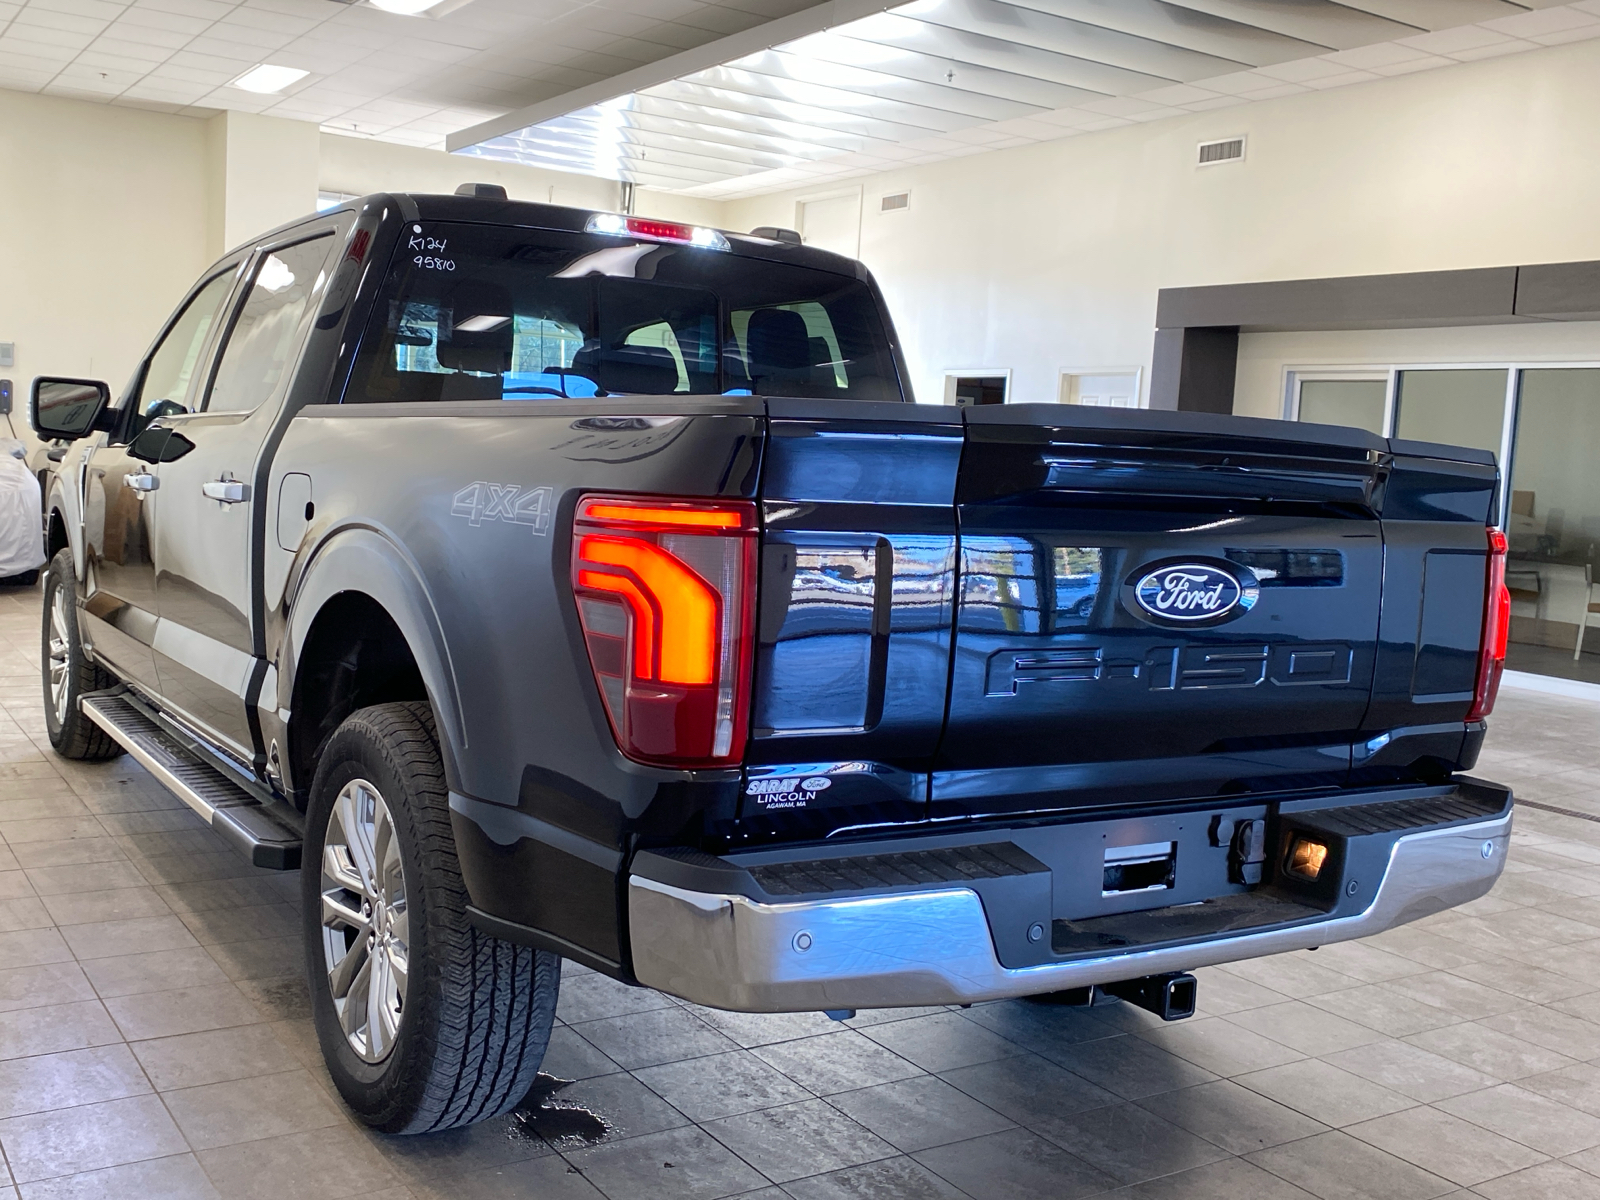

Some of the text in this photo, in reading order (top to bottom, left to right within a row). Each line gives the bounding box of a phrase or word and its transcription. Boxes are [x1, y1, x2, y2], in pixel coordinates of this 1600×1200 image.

[408, 235, 447, 252] K124
[413, 255, 456, 271] 95810
[1155, 572, 1224, 610] Ford
[984, 643, 1354, 697] F-150
[746, 779, 800, 795] SARAT
[757, 791, 816, 803] LINCOLN
